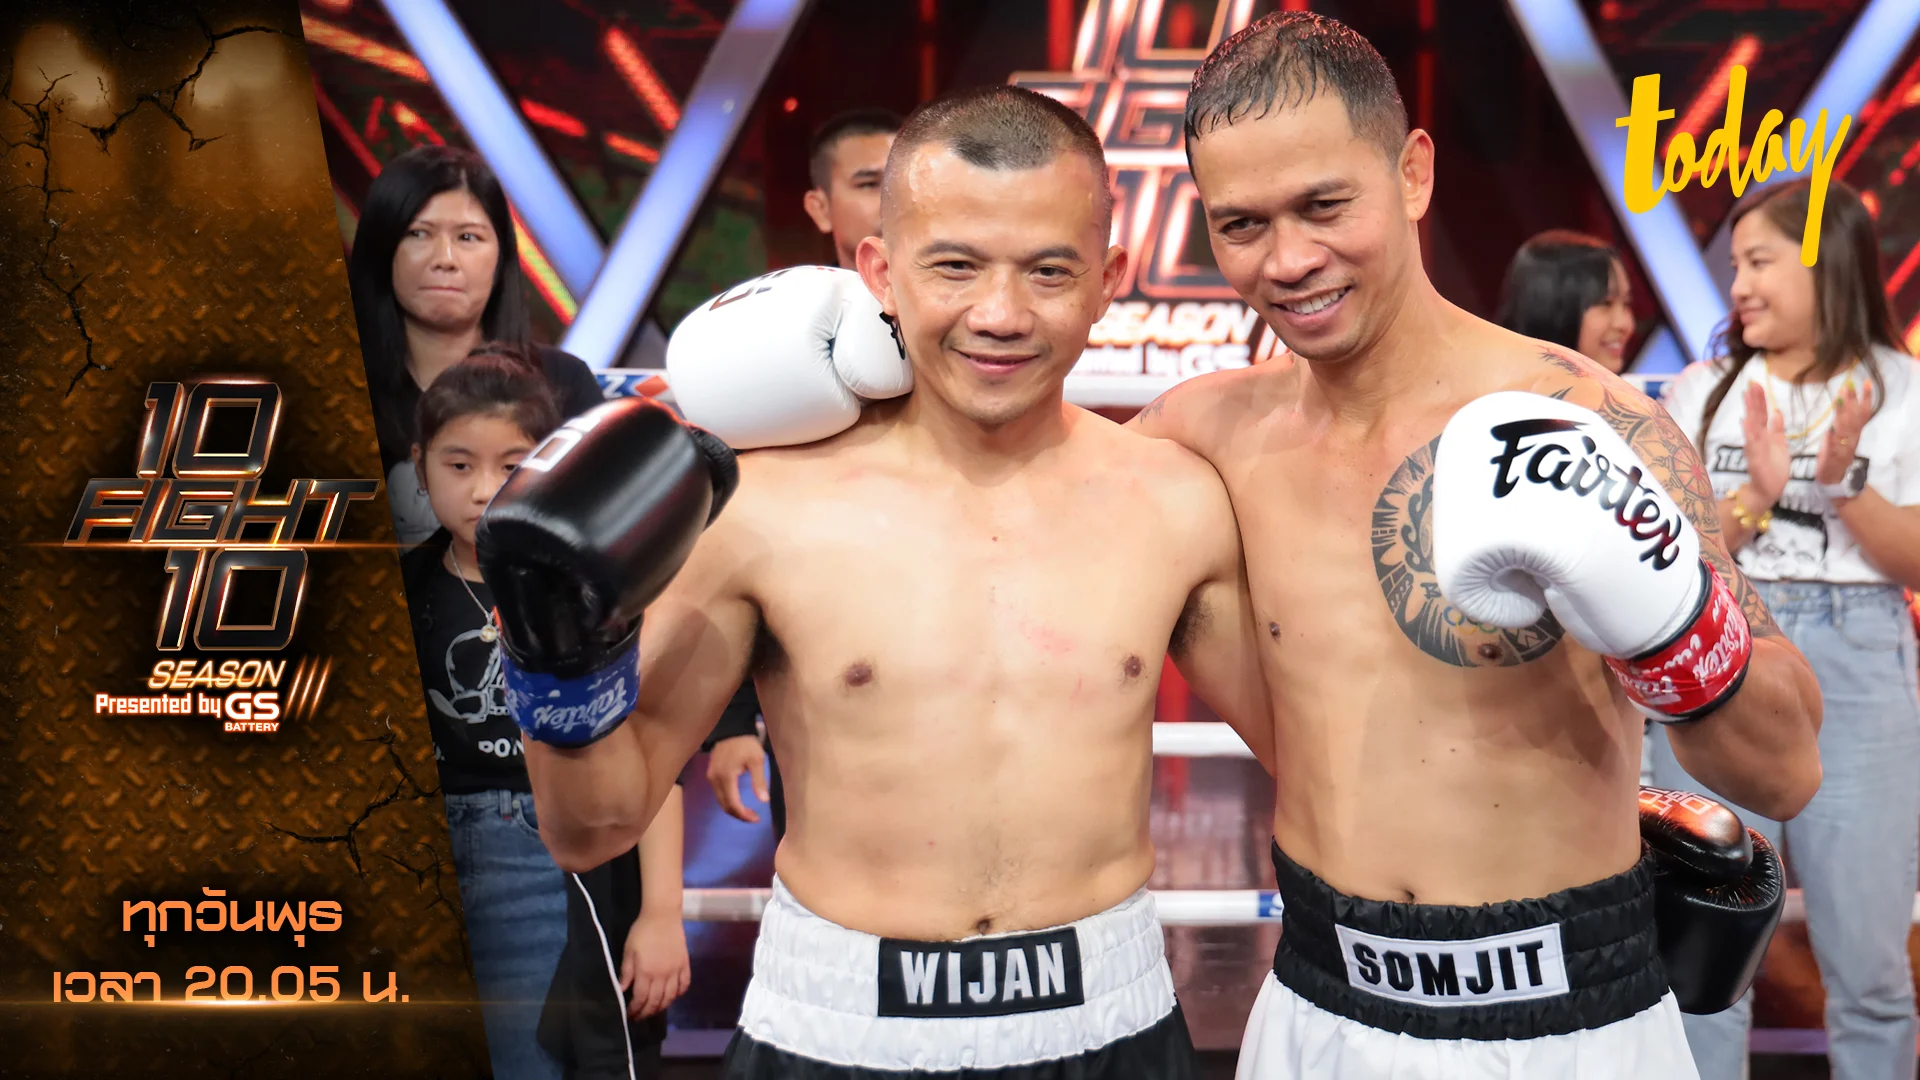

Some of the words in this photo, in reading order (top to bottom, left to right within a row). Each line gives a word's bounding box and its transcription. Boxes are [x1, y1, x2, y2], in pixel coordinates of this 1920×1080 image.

[1489, 417, 1682, 571] Fairtex
[532, 676, 629, 739] Fairtex
[900, 942, 1067, 1005] WIJAN
[1351, 939, 1544, 997] SOMJIT
